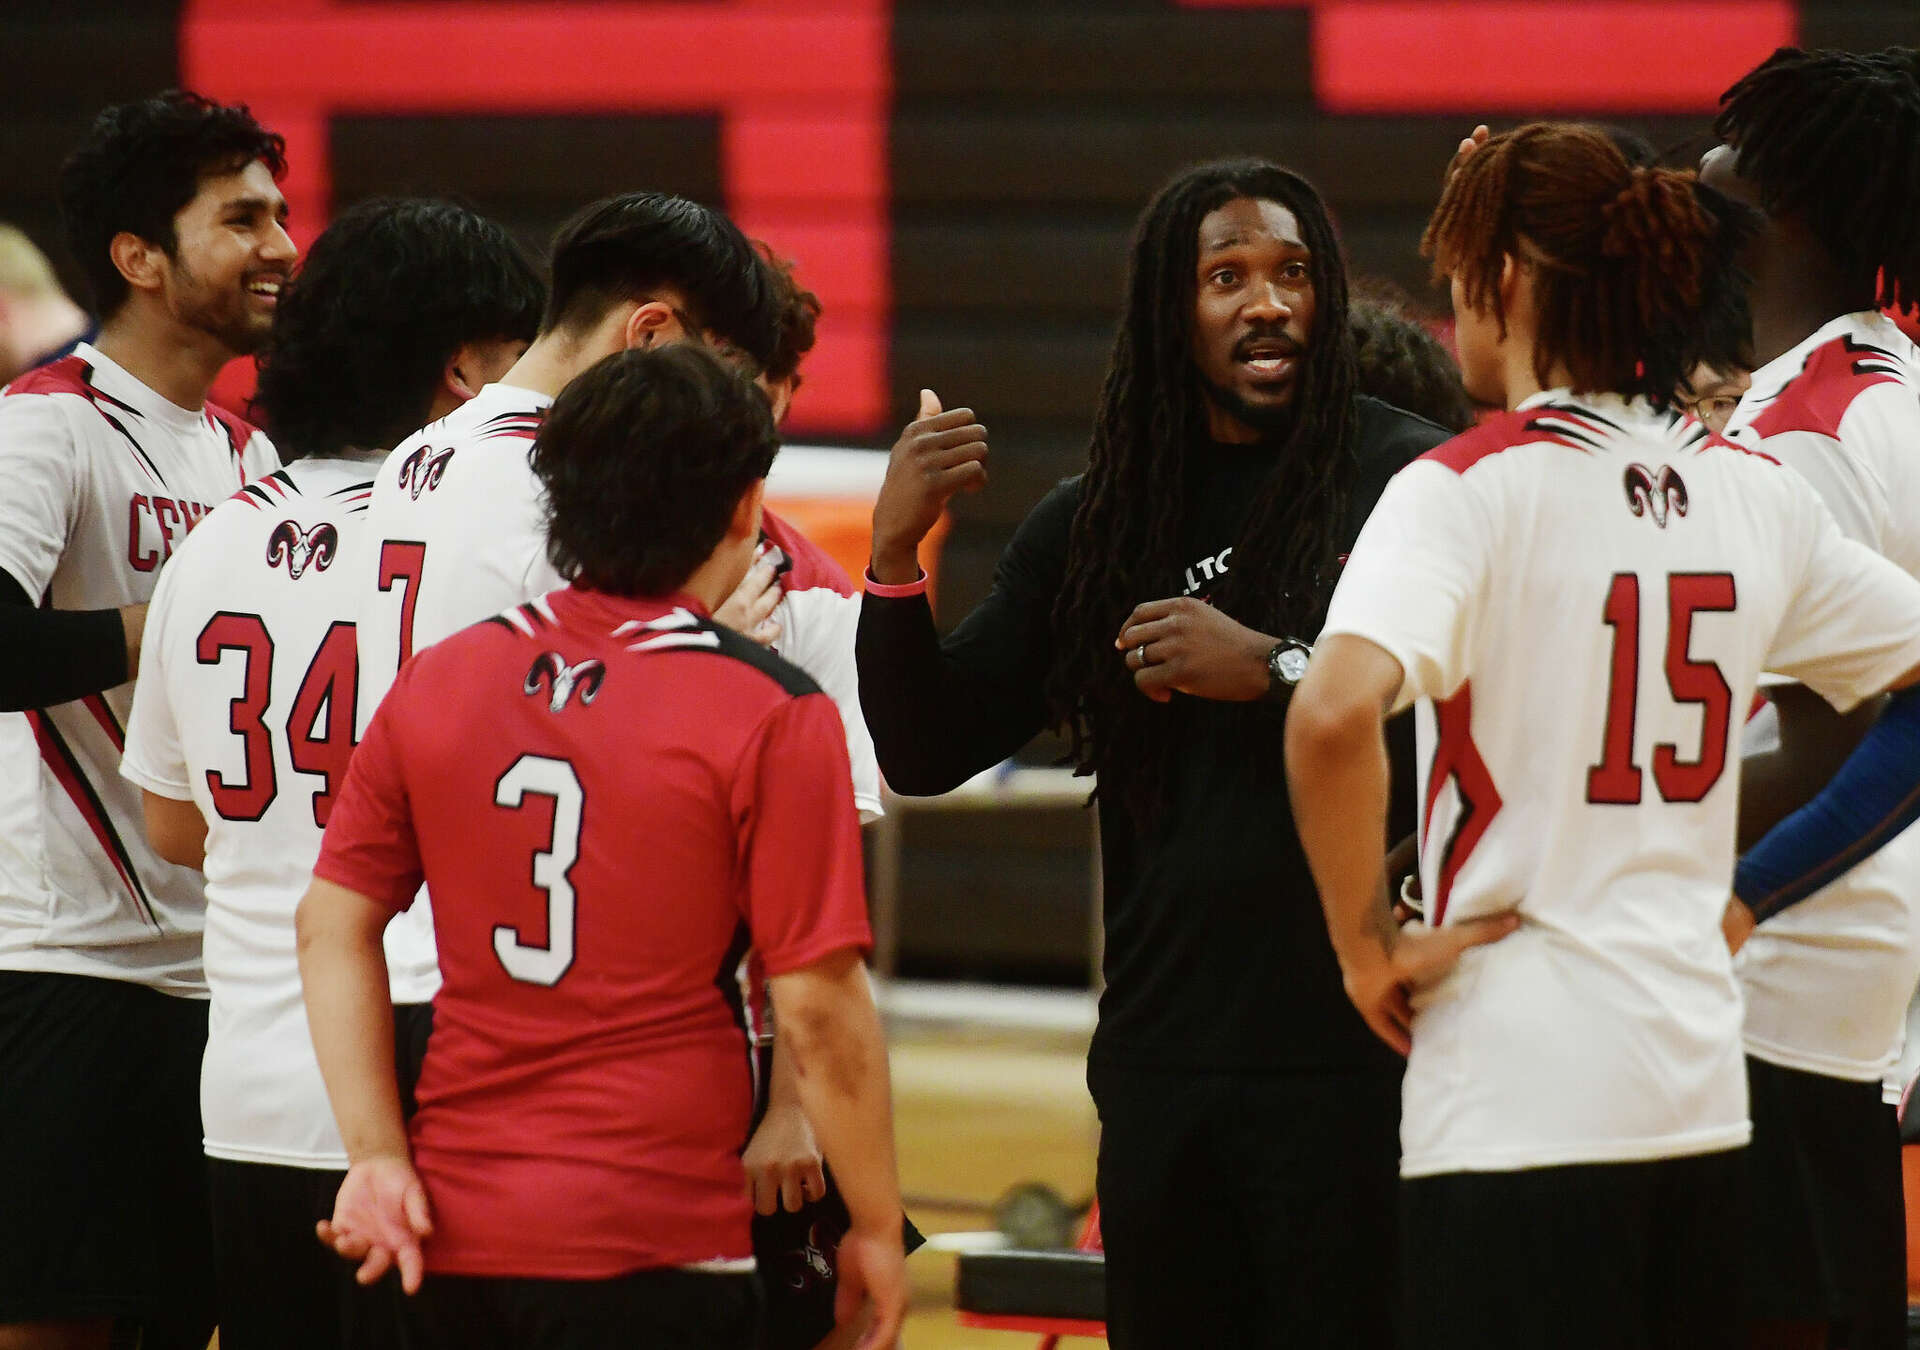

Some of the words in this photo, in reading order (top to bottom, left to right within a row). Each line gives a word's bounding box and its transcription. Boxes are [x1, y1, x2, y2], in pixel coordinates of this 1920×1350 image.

[195, 610, 361, 829] 34
[377, 539, 428, 673] 7
[1585, 570, 1737, 805] 15
[493, 752, 586, 987] 3
